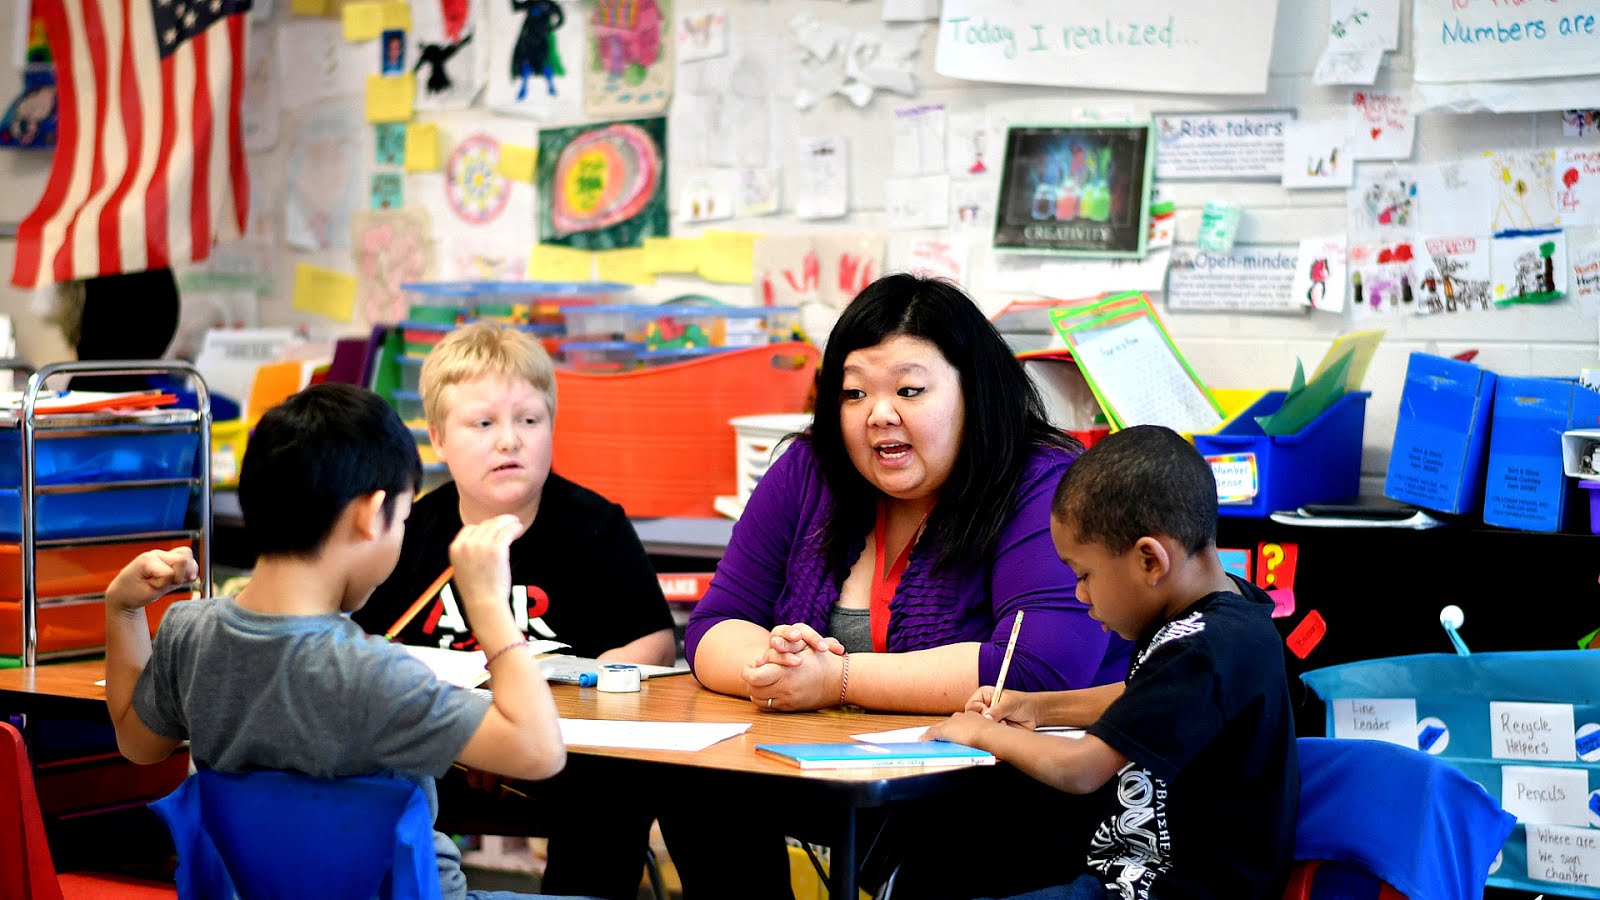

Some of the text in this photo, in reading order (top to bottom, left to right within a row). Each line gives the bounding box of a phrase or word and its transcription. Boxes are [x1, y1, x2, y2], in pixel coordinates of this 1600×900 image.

[947, 16, 1016, 60] Today
[1027, 24, 1049, 52] I
[1442, 15, 1596, 44] Numbers are
[1180, 118, 1284, 138] Risk-takers
[1023, 225, 1111, 242] CREATIVITY
[1213, 464, 1249, 476] Number
[1351, 699, 1377, 716] Line
[1353, 717, 1391, 731] Leader
[1501, 712, 1552, 740] Recycle
[1505, 738, 1549, 755] Helpers
[1517, 782, 1566, 803] Pencils
[1536, 826, 1597, 849] Where are
